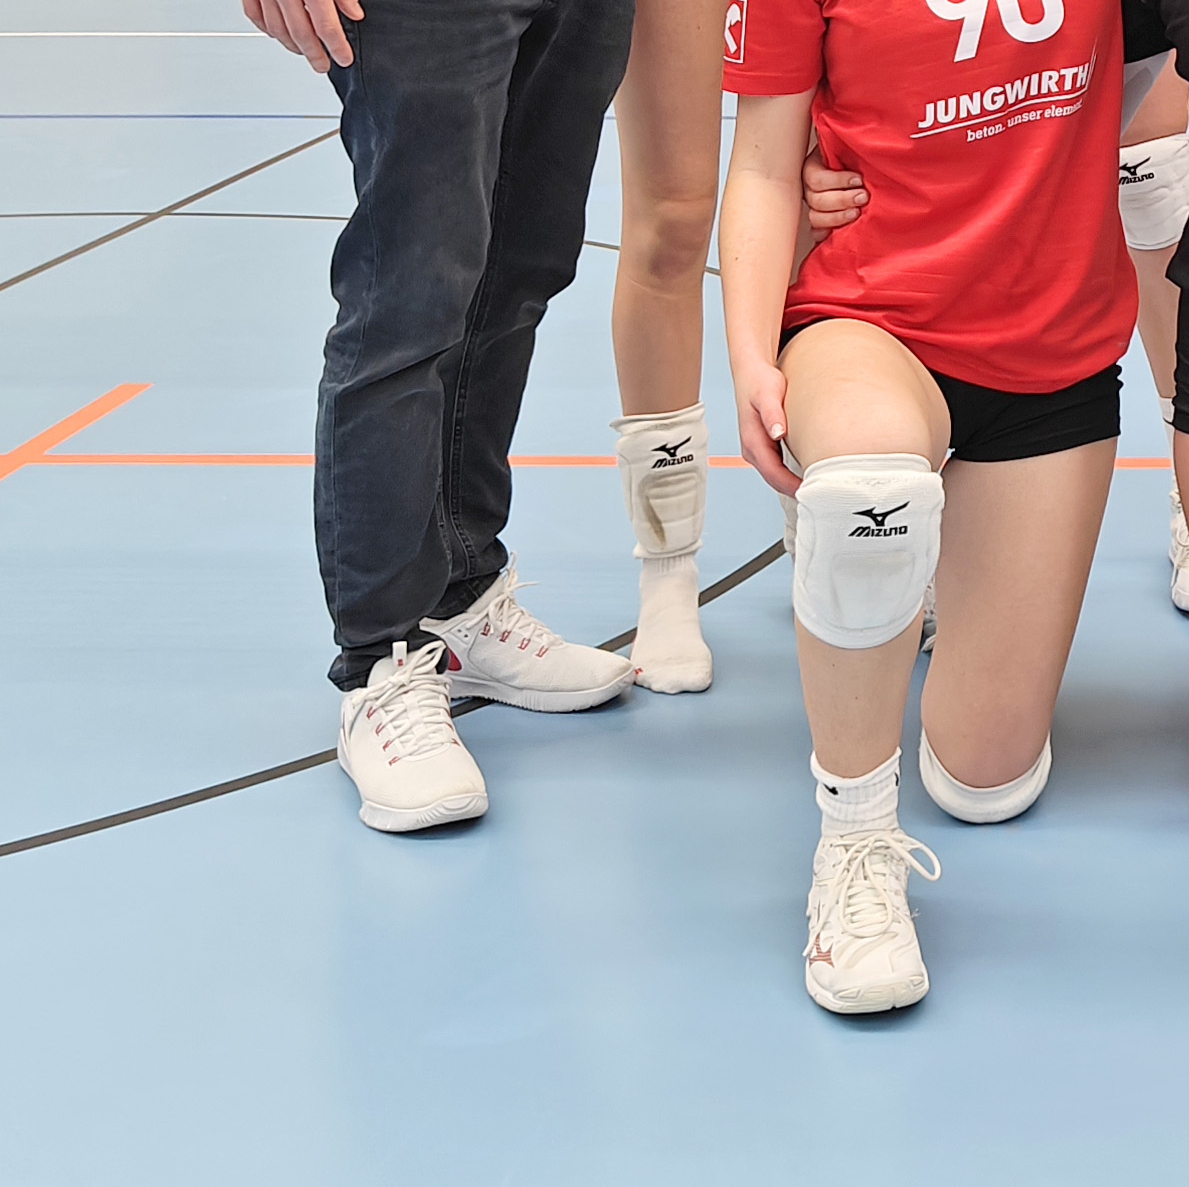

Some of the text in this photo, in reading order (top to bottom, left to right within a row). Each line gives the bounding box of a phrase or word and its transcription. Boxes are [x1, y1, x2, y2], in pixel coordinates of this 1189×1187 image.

[918, 63, 1090, 128] JUNGWIRTH
[967, 122, 1006, 142] beton.
[1007, 110, 1043, 127] unser
[848, 525, 908, 537] MIZUNO
